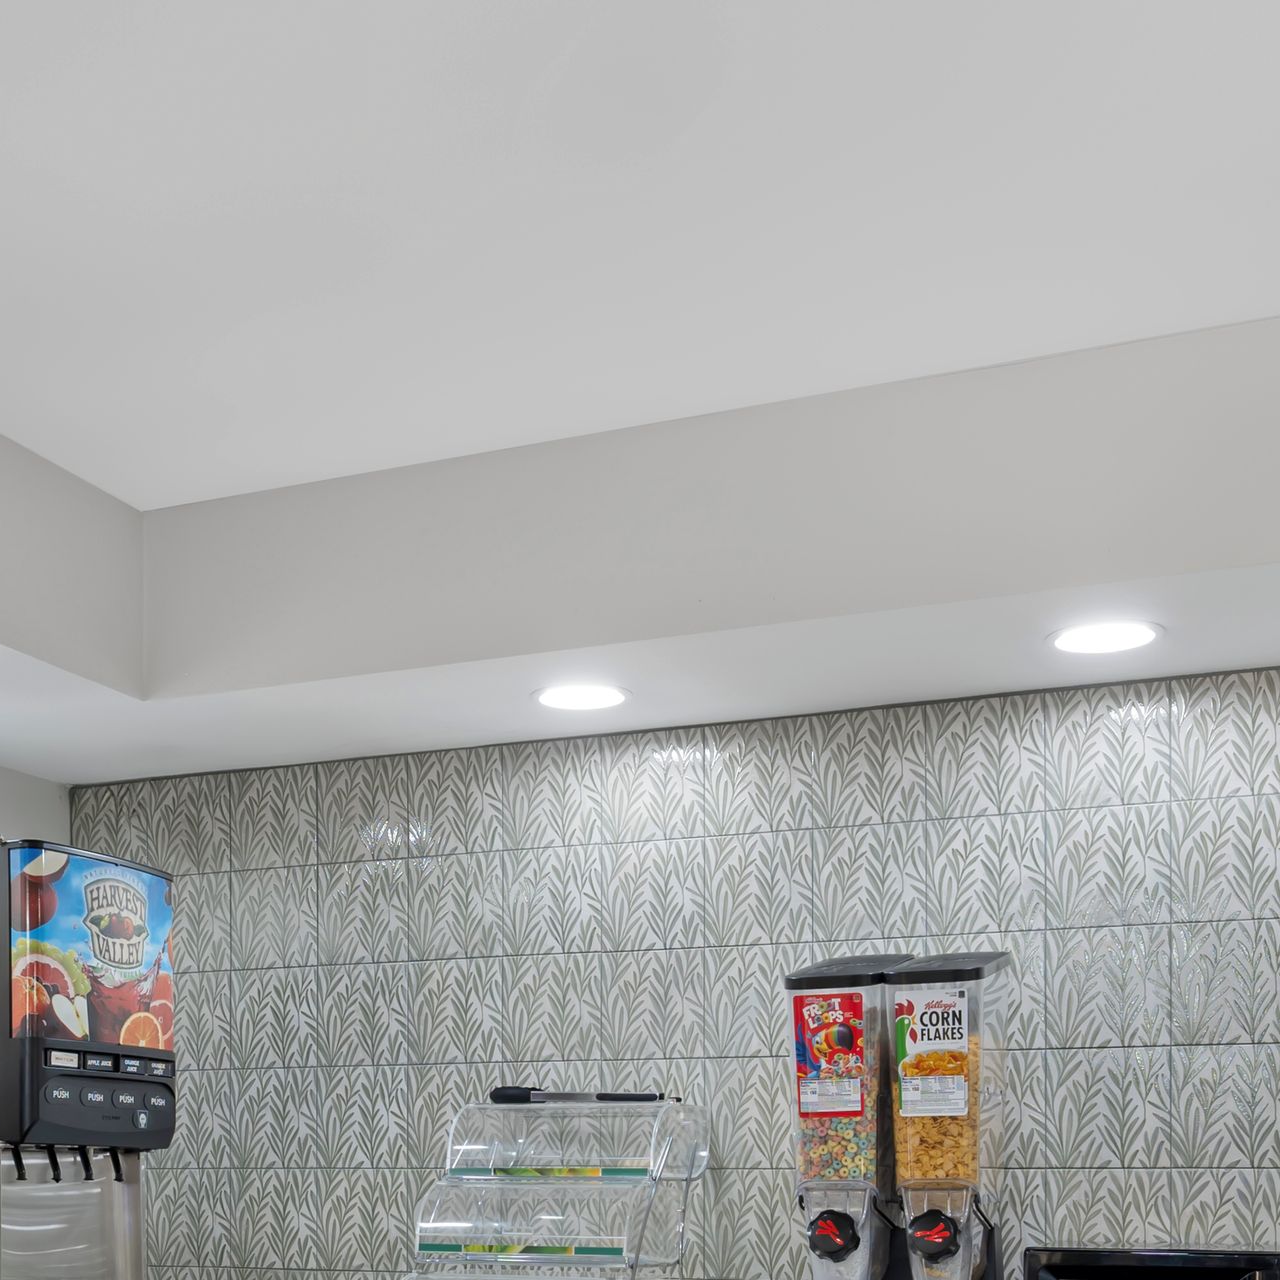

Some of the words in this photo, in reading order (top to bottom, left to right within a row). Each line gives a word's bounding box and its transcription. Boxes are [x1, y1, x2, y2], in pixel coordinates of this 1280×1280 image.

[89, 884, 146, 923] HARVEST
[95, 932, 141, 966] VALLEY
[802, 997, 841, 1021] FROOT
[923, 999, 958, 1013] Kellogg's
[808, 1009, 844, 1029] LOOPS
[919, 1009, 962, 1028] CORN
[920, 1026, 964, 1042] FLAKES
[52, 1090, 70, 1099] PUSH
[87, 1093, 104, 1102] PUSH
[119, 1095, 135, 1104] PUSH
[150, 1097, 166, 1107] PUSH
